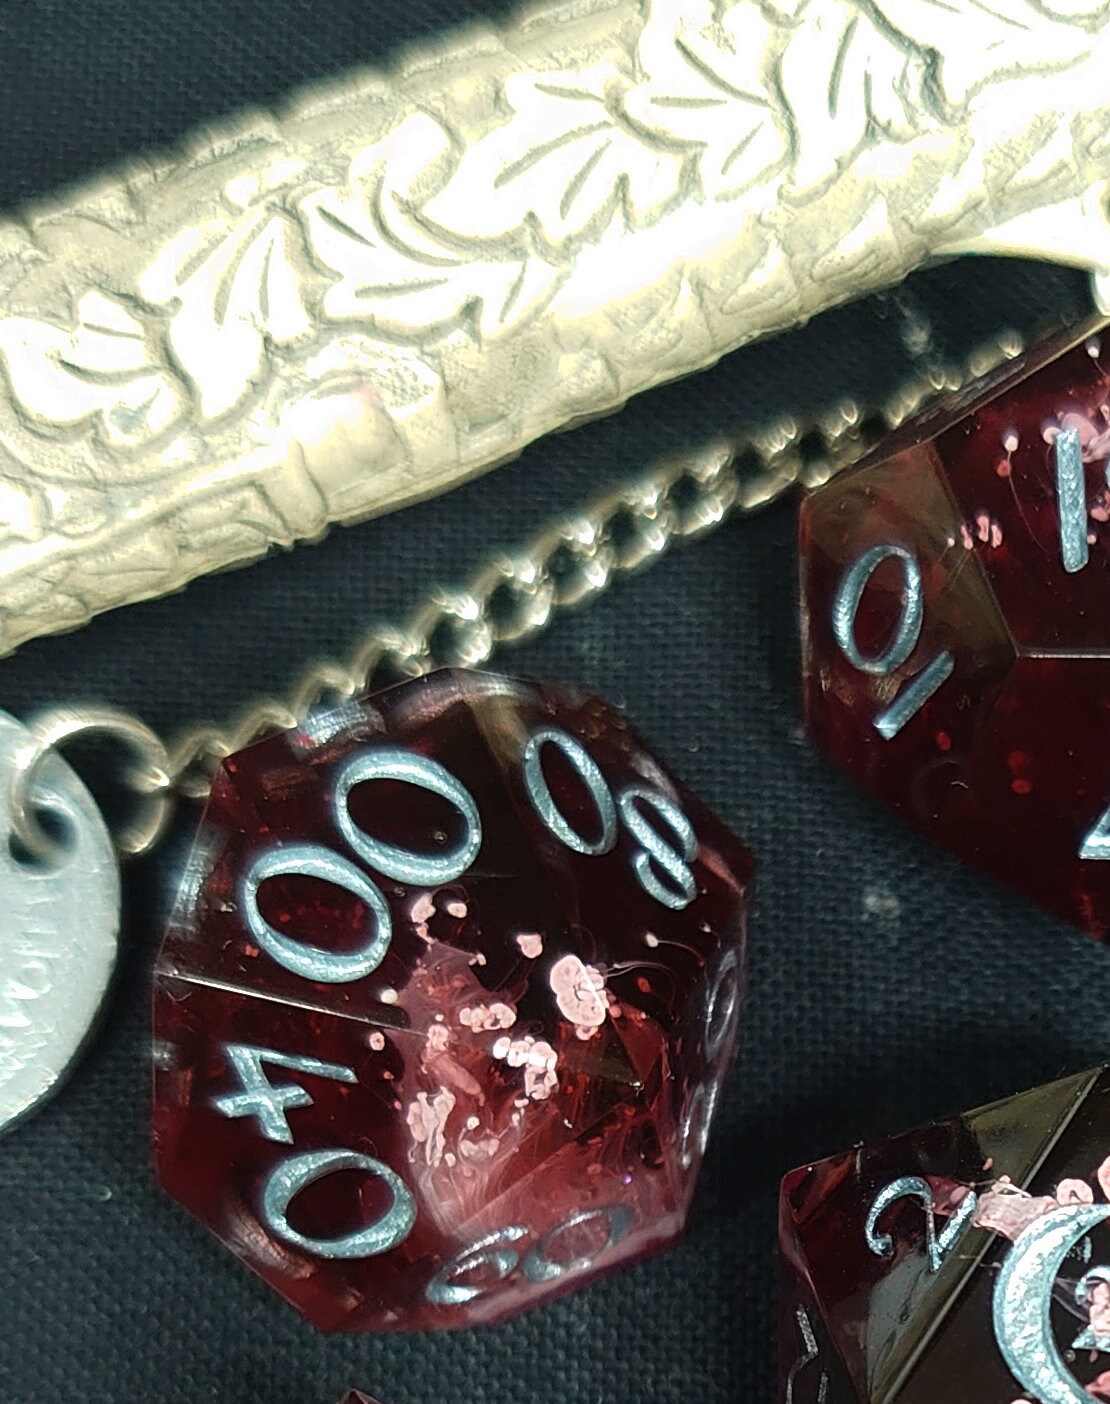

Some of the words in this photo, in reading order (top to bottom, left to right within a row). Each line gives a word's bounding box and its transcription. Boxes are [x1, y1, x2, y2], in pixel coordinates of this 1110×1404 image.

[243, 748, 483, 983] 00
[523, 730, 700, 911] 80
[215, 1043, 418, 1260] 40
[864, 1174, 978, 1272] 2
